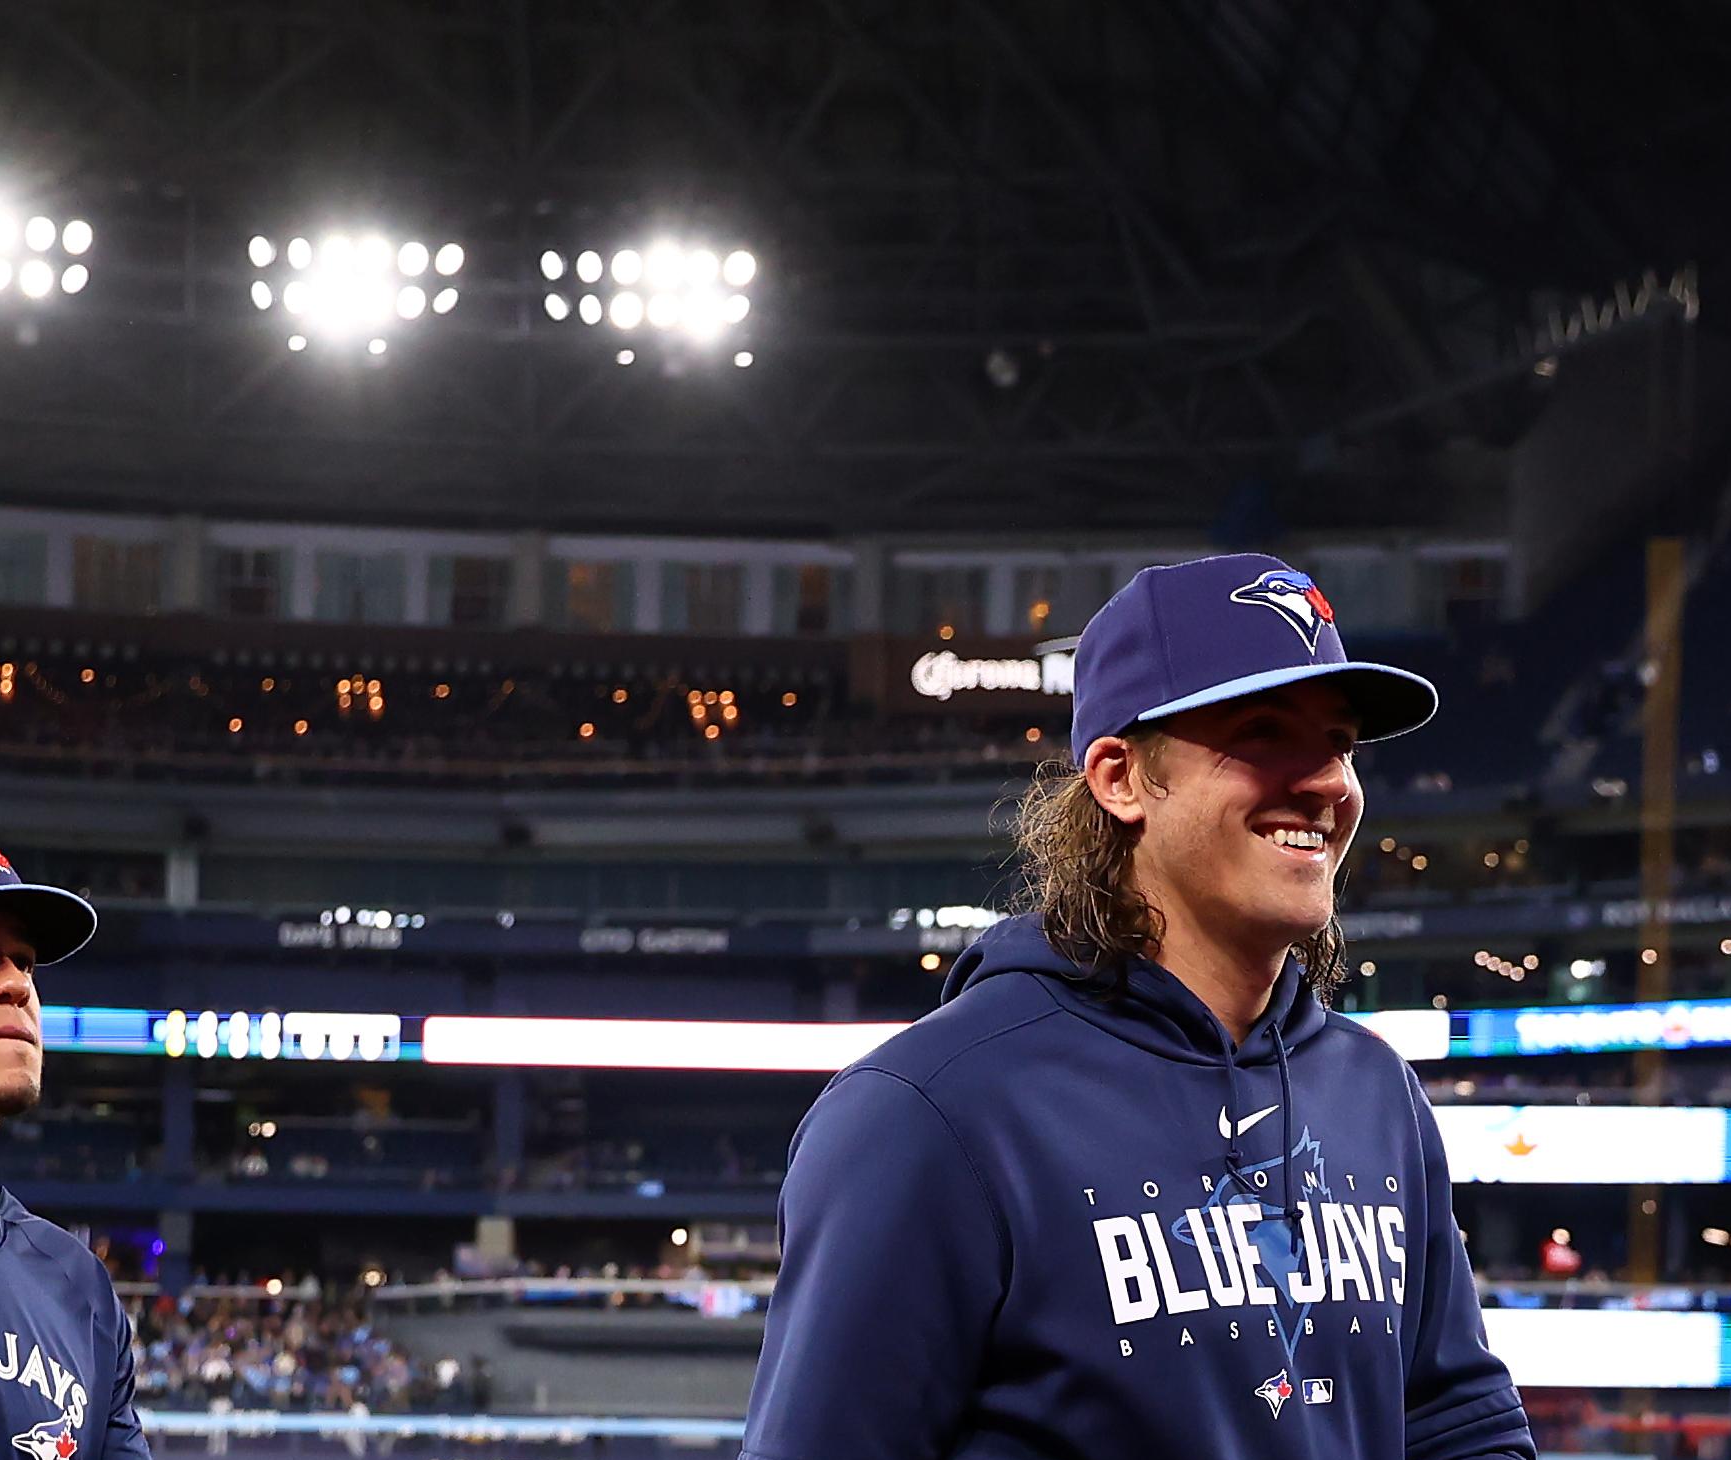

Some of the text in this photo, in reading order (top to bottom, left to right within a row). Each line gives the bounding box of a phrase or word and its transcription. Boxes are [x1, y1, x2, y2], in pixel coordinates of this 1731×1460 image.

[1083, 1170, 1398, 1206] TORONTO
[1092, 1200, 1406, 1325] BLUE JAYS
[1119, 1316, 1394, 1358] BASEBAL
